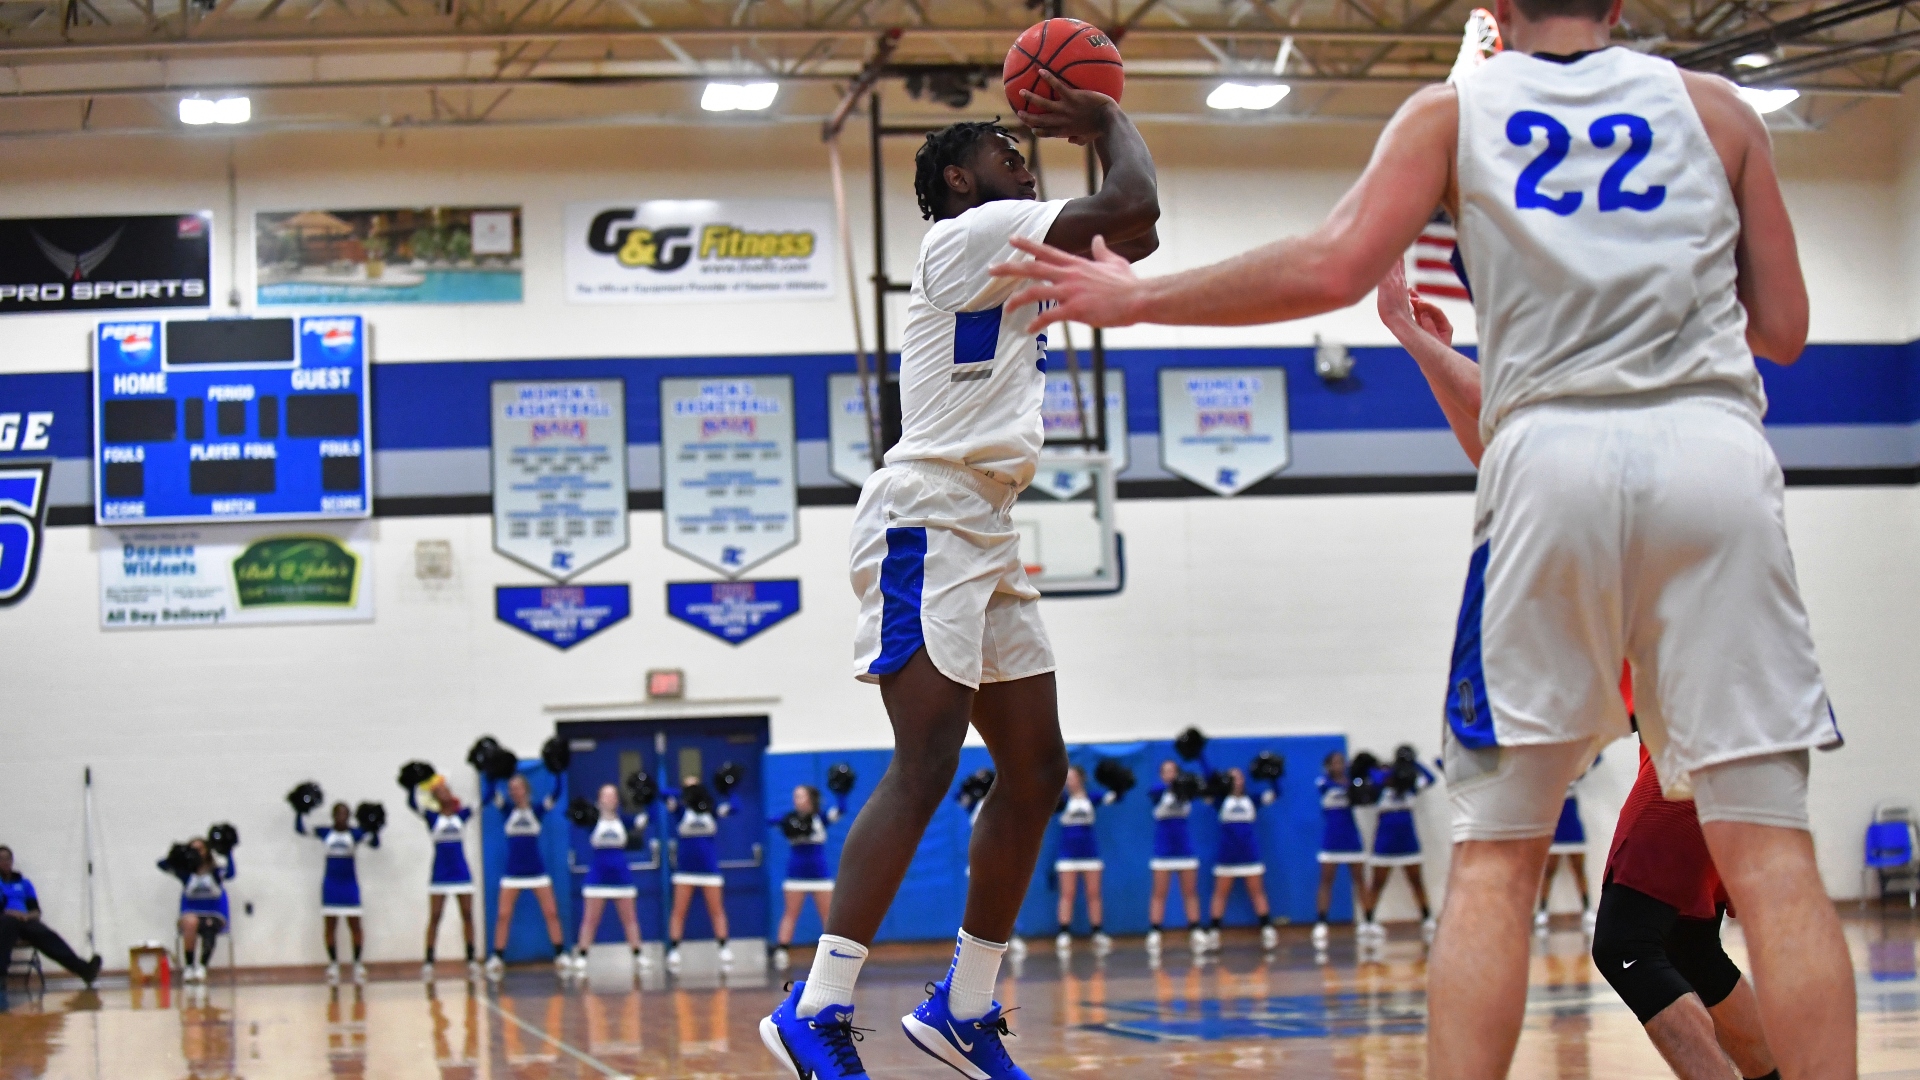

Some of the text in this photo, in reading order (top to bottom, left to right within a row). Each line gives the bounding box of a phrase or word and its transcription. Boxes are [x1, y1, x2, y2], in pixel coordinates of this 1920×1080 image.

[1505, 110, 1667, 217] 22
[587, 207, 815, 273] G&G Fitness
[0, 279, 205, 302] PRO SPORTS
[101, 324, 154, 341] PEPSI
[303, 319, 356, 336] PEPSI
[113, 373, 168, 395] HOME
[291, 367, 352, 390] GUEST
[208, 385, 255, 402] PERIOD
[103, 445, 145, 463] FOULS
[190, 442, 277, 461] PLAYER FOUL
[319, 439, 361, 457] FOULS
[122, 543, 195, 559] Daemen
[122, 560, 197, 577] Wildcats
[106, 605, 226, 626] All Day Delivery!
